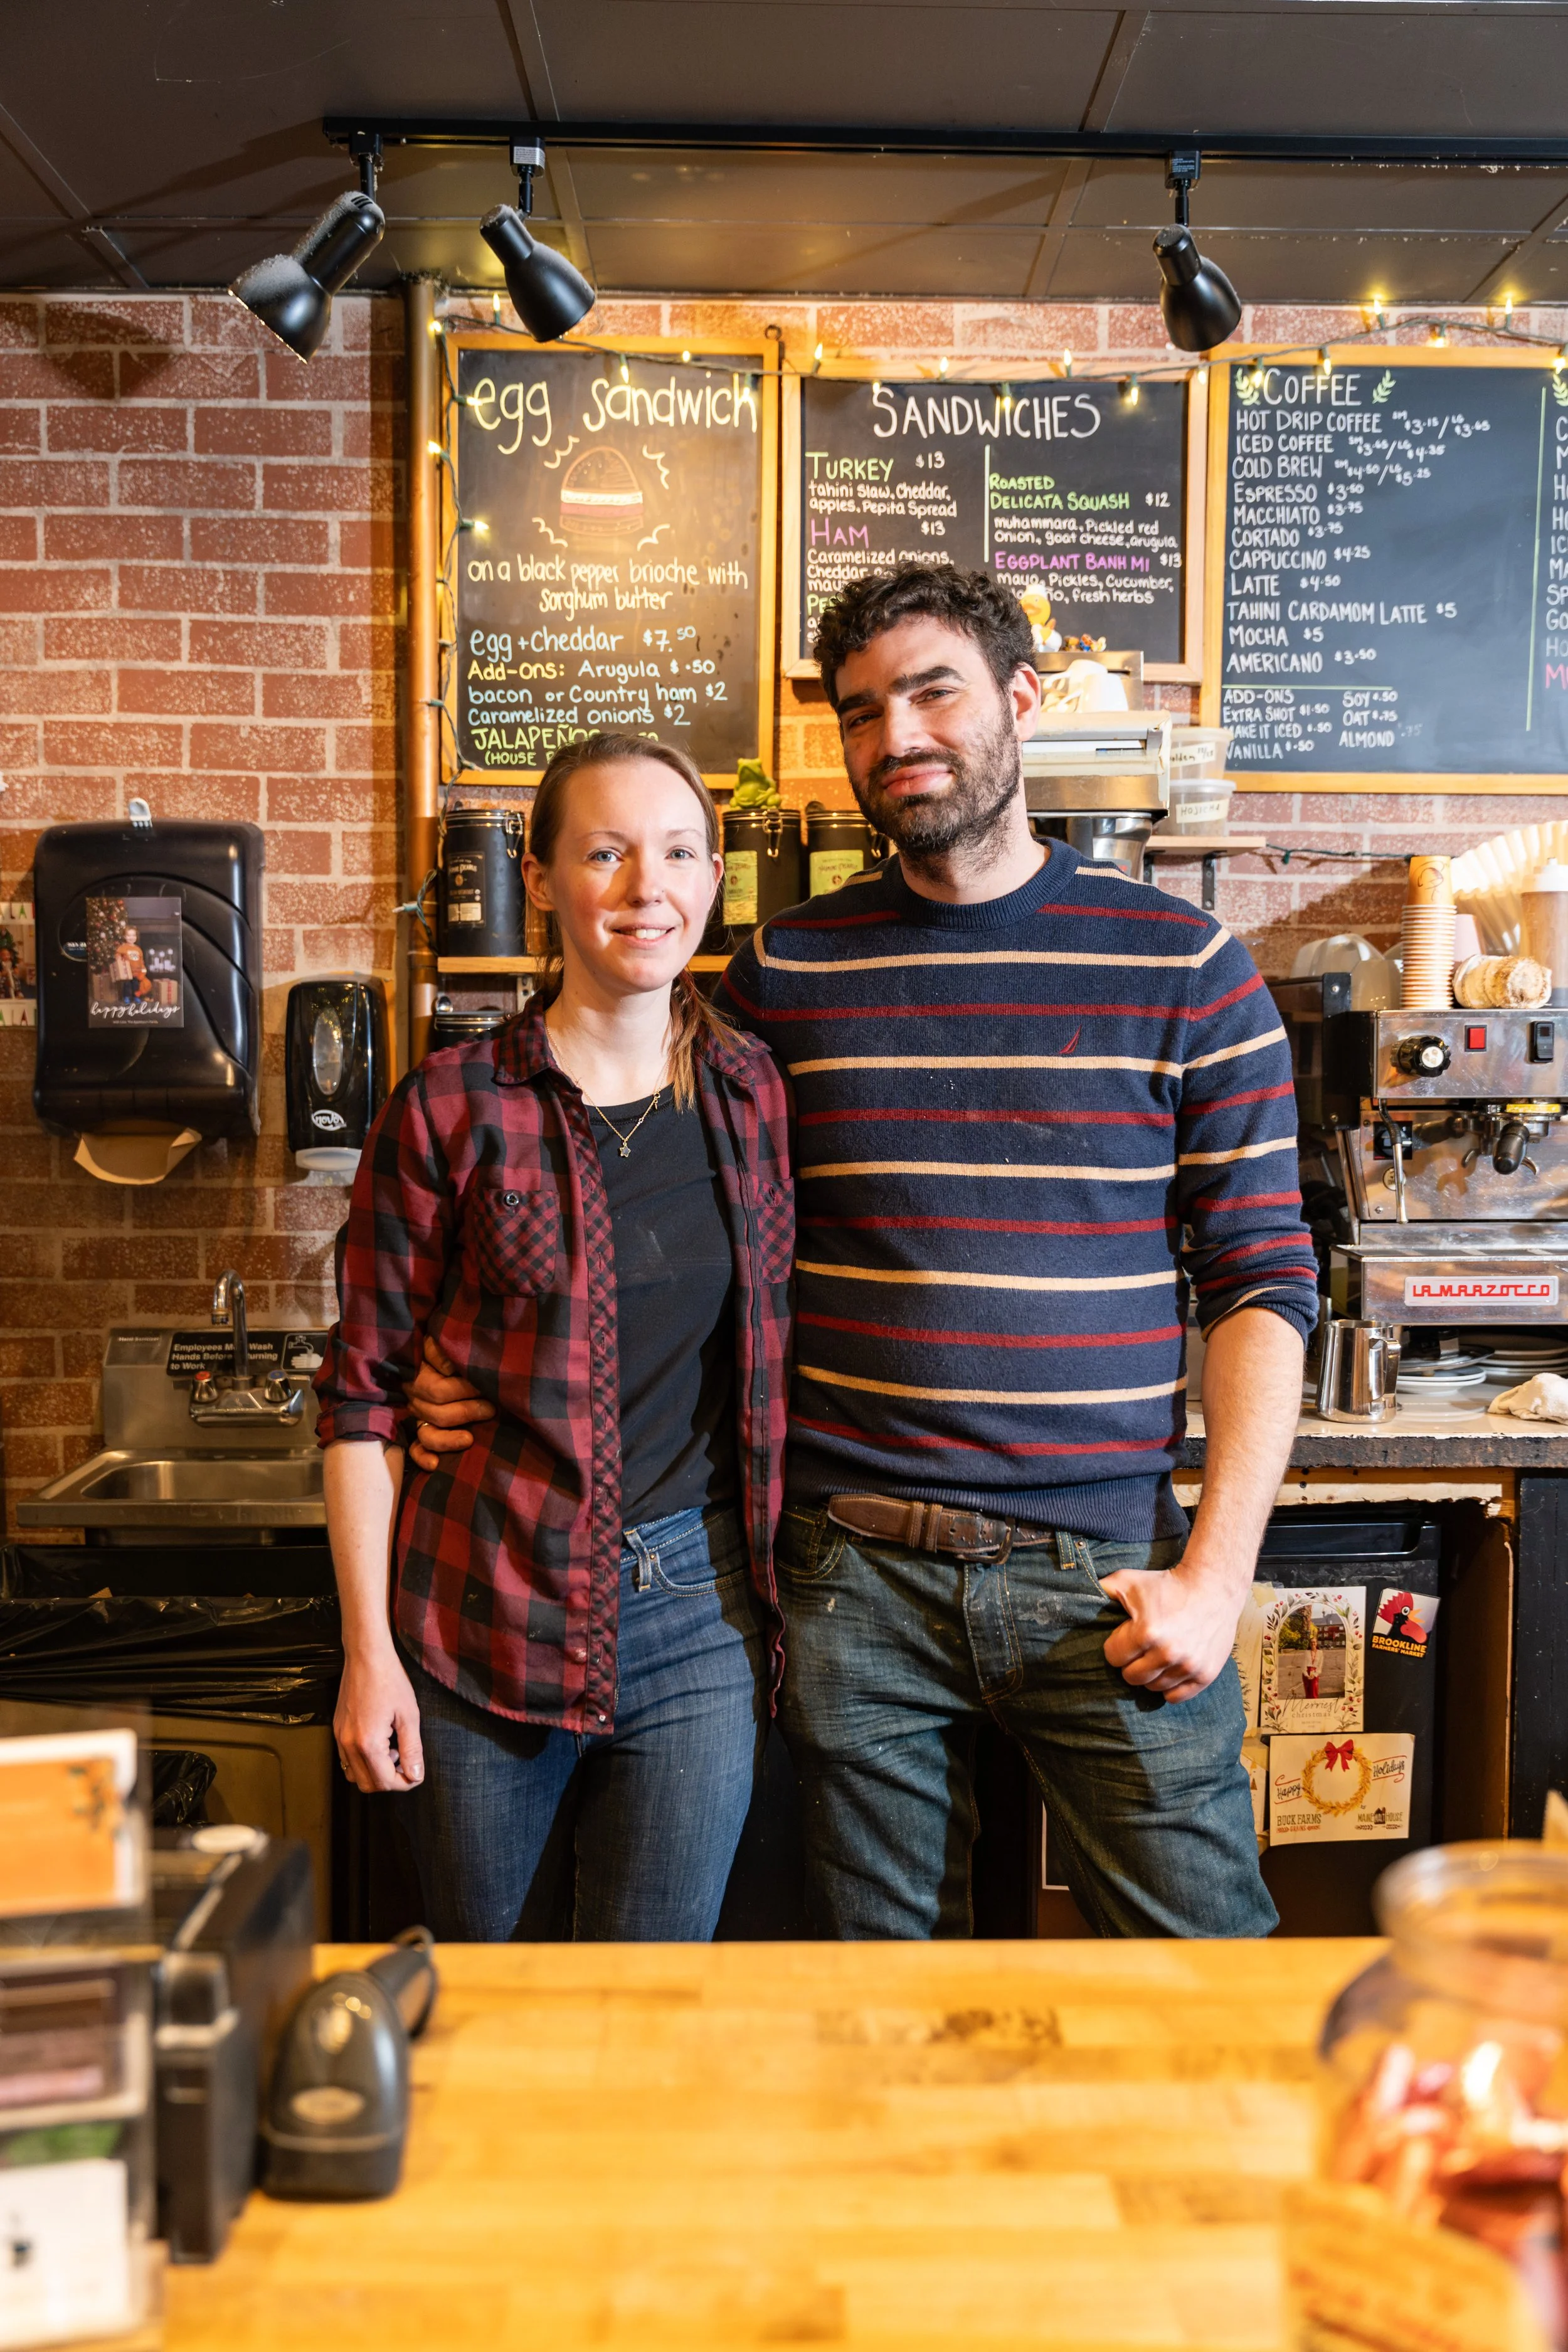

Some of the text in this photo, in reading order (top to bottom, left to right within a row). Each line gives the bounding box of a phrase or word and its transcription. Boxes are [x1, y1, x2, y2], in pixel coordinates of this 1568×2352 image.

[1263, 368, 1362, 406] COFFEE
[474, 378, 552, 454] egg
[872, 387, 1101, 440] SANDWICHES
[1237, 410, 1271, 432] HOT
[1276, 410, 1323, 432] DRIP
[1327, 412, 1383, 434] COFFEE
[1237, 435, 1274, 455] ICED
[1278, 434, 1334, 454] COFFEE
[805, 452, 894, 482] TURKEY
[1232, 455, 1272, 479] COLD
[1278, 455, 1323, 479] BREW
[808, 479, 853, 497] tahini
[1234, 482, 1318, 503] ESPRESSO
[990, 491, 1171, 511] DELICATA SQUASH $12
[1233, 506, 1320, 526] MACCHIATO
[811, 517, 945, 548] HAM $13
[1138, 520, 1159, 534] red
[1231, 527, 1300, 548] CORTADO
[1045, 530, 1076, 546] goat
[995, 551, 1182, 572] EGGPLANT BANH MI $13
[1229, 549, 1327, 571] CAPPUCCINO
[468, 554, 748, 590] on a black pepper brioche with
[1231, 572, 1281, 597] LATTE
[614, 585, 674, 611] butter
[1112, 587, 1155, 604] herbs
[1227, 600, 1458, 626] TAHINI CARDAMOM LATTE $5
[470, 629, 512, 662] egg
[1229, 625, 1290, 648] MOCHA
[578, 659, 660, 684] Arugula
[1226, 652, 1323, 674] AMERICANO
[469, 685, 532, 705] bacon
[546, 691, 564, 702] or
[656, 682, 697, 703] ham
[706, 681, 728, 701] $2
[1224, 689, 1295, 705] ADD-ONS
[1342, 690, 1371, 707] SOY
[587, 707, 655, 725] onions
[664, 704, 691, 726] $2
[1222, 706, 1263, 723] EXTRA
[1264, 706, 1296, 723] SHOT
[1343, 709, 1372, 726] OAT
[1259, 723, 1271, 739] IT
[1274, 723, 1303, 739] ICED
[1338, 730, 1396, 748] ALMOND
[484, 751, 537, 766] (HOUSE
[172, 1352, 201, 1360] Hands
[203, 1352, 233, 1360] Before
[174, 1343, 223, 1353] Employees
[182, 1362, 206, 1370] Work
[1372, 1635, 1428, 1653] BROOKLINE
[1400, 1649, 1424, 1658] MARKET
[1373, 1759, 1406, 1777] Holidays
[1277, 1783, 1301, 1800] Happy
[1276, 1813, 1322, 1826] BUCK FARMS
